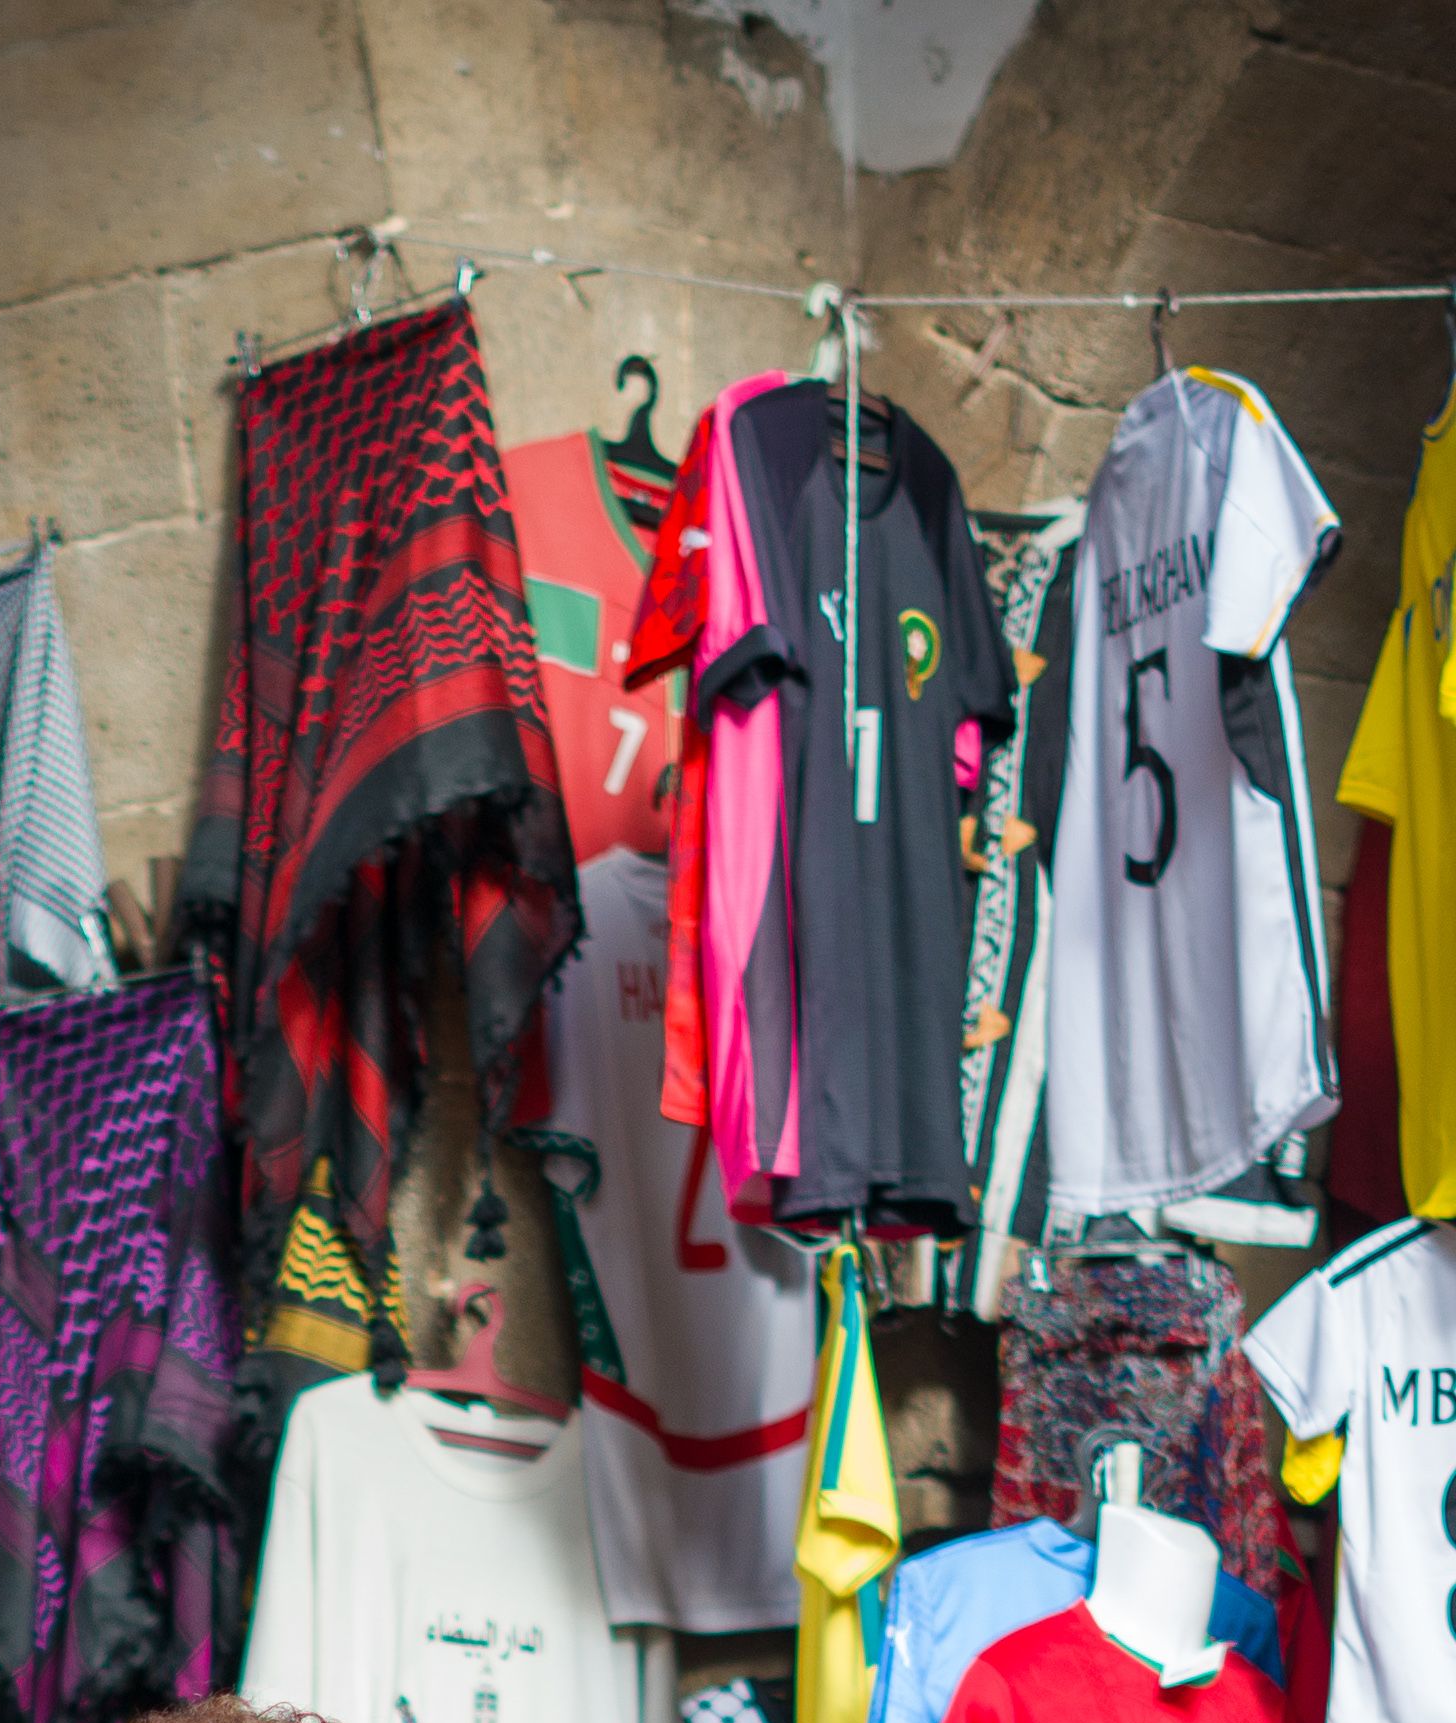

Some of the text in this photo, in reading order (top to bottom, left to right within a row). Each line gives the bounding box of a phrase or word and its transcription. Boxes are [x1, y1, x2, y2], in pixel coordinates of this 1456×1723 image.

[604, 706, 648, 796] 7
[853, 707, 882, 823] 1
[1124, 648, 1178, 887] 5
